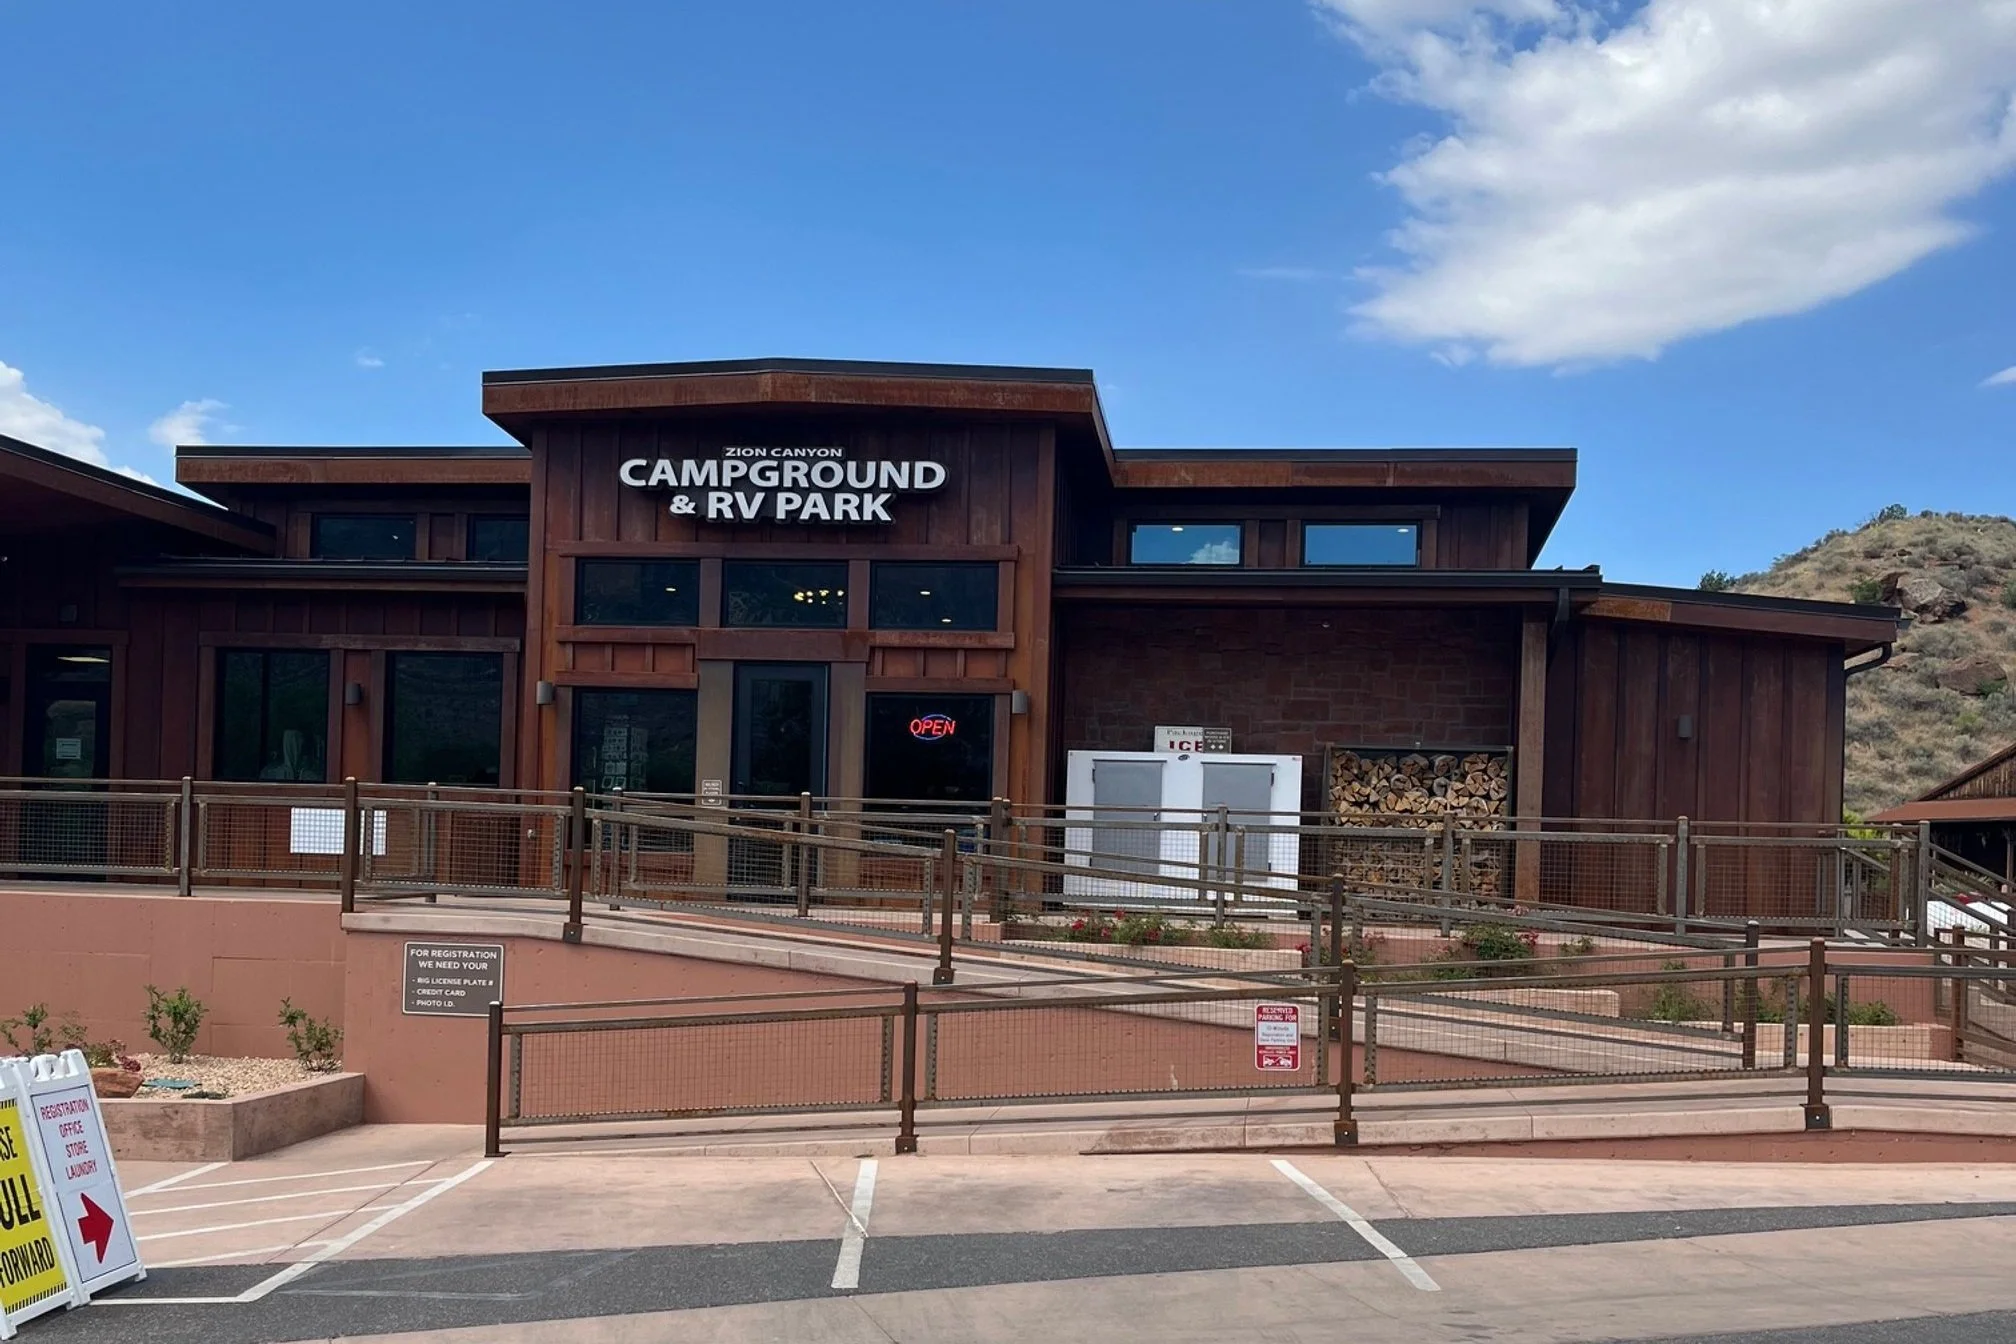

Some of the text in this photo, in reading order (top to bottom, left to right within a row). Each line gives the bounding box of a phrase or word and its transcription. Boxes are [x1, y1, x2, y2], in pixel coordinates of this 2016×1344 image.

[725, 448, 842, 457] ZION CANYON
[619, 459, 946, 489] CAMPGROUND
[669, 492, 892, 521] & RV PARK
[910, 719, 956, 735] OPEN
[1169, 740, 1204, 753] ICE
[410, 949, 497, 959] FOR REGISTRATION
[435, 961, 460, 969] NEED
[462, 962, 488, 970] YOUR
[40, 1098, 89, 1120] REGISTRATION
[59, 1120, 84, 1138] OFFICE
[0, 1126, 18, 1161] SE
[65, 1140, 89, 1158] STORE
[65, 1159, 97, 1180] LAUNDRY
[0, 1173, 41, 1230] ULL
